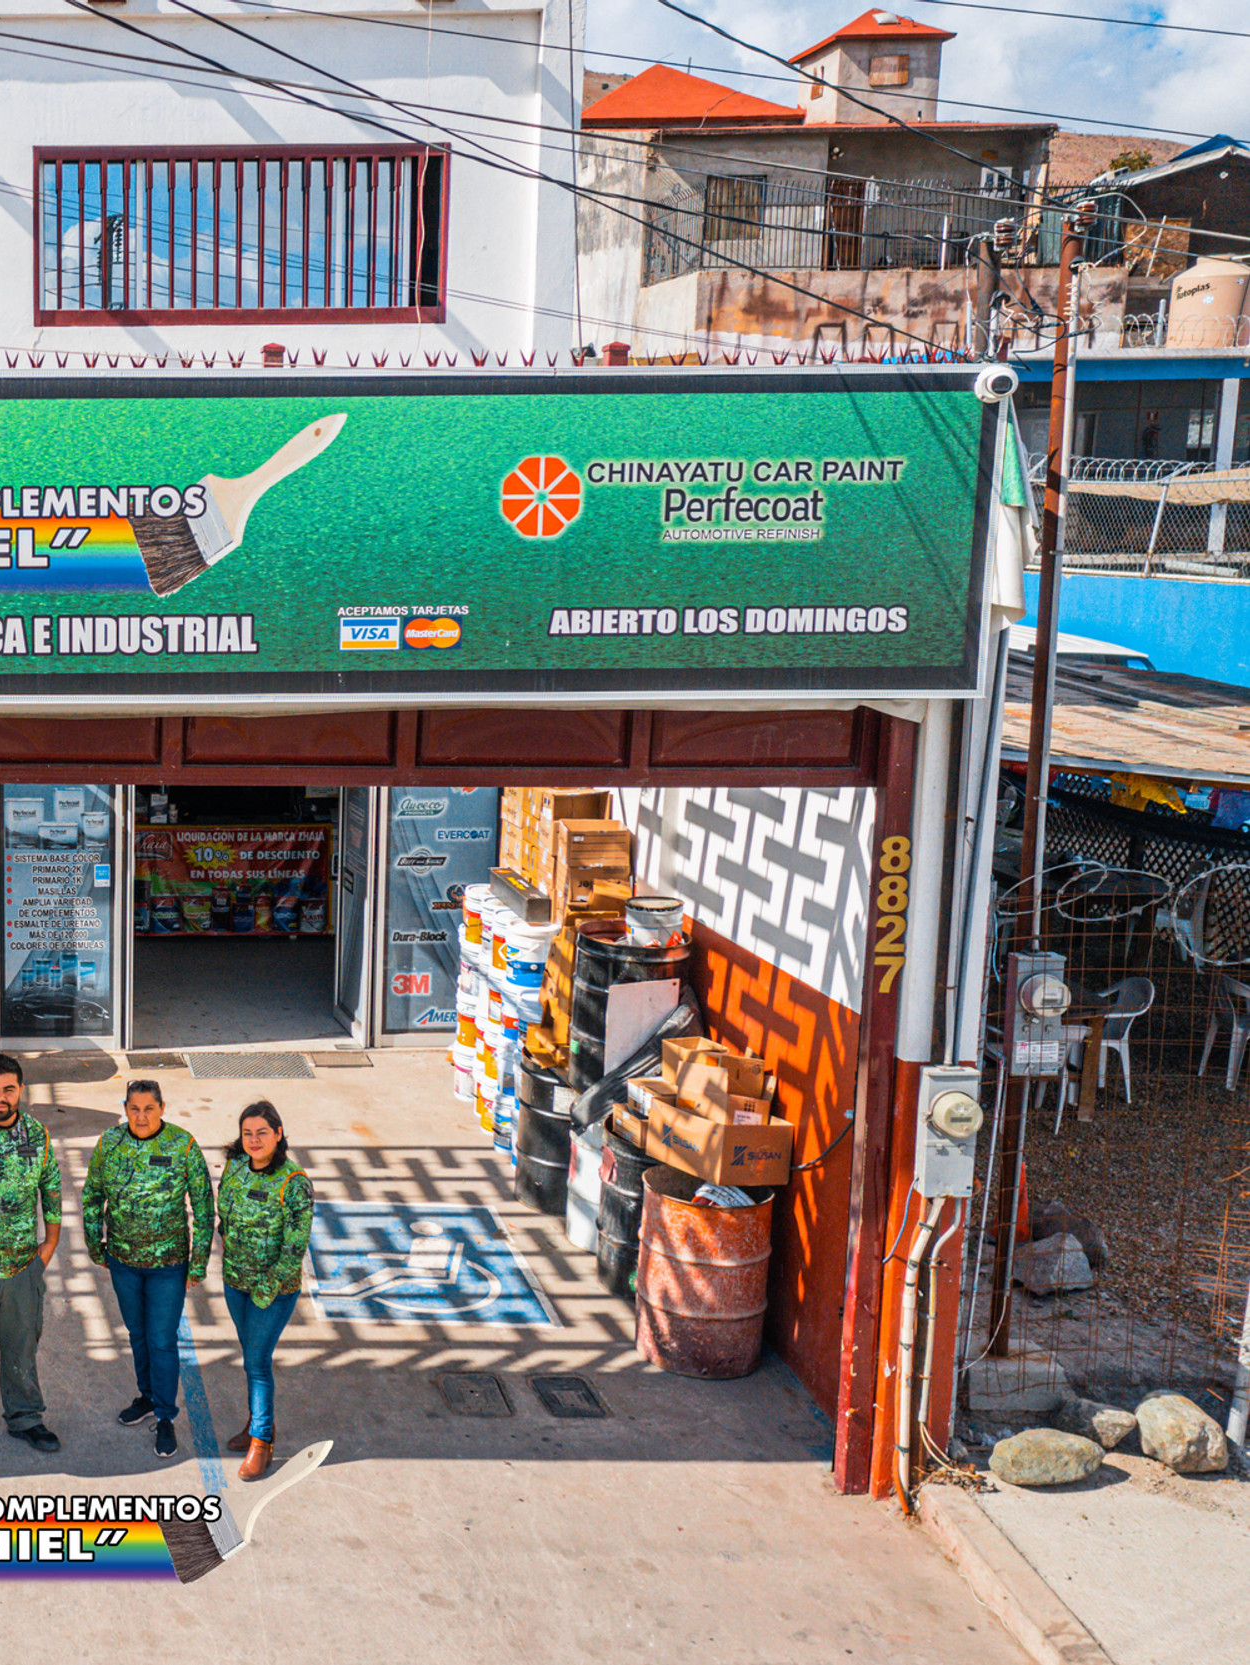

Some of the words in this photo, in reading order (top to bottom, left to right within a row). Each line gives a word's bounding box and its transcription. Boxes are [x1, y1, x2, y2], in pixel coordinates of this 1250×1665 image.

[587, 461, 744, 484] CHINAYATU
[753, 460, 816, 483] CAR
[823, 459, 904, 482] PAINT
[663, 486, 824, 523] Perfecoat
[662, 528, 753, 541] AUTOMOTIVE
[755, 527, 821, 540] REFINISH
[337, 606, 410, 616] ACEPTAMOS
[412, 605, 469, 615] TARJETAS
[548, 607, 678, 634] ABIERTO
[684, 606, 738, 633] LOS
[744, 606, 908, 633] DOMINGOS
[32, 616, 52, 655] E
[58, 616, 257, 654] INDUSTRIAL
[351, 628, 391, 641] VISA
[405, 627, 459, 641] MasterCard
[237, 832, 248, 842] DE
[251, 832, 262, 842] LA
[265, 832, 295, 842] MARCA
[437, 830, 490, 839] EVERCOAT
[14, 855, 48, 863] SISTEMA
[50, 855, 70, 863] BASE
[72, 854, 100, 863] COLOR
[240, 851, 254, 860] DE
[257, 851, 320, 860] DESCUENTO
[190, 870, 204, 878] EN
[208, 869, 243, 878] TODAS
[246, 869, 265, 878] SUS
[38, 887, 77, 895] MASILLAS
[23, 898, 51, 906] AMPLIA
[54, 898, 92, 906] VARIEDAD
[19, 909, 29, 917] DE
[31, 908, 96, 917] COMPLEMENTOS
[873, 836, 911, 994] 8827
[14, 920, 49, 928] ESMALTE
[51, 920, 62, 928] DE
[64, 919, 100, 928] URETANO
[393, 931, 447, 941] Dura-Block
[10, 942, 48, 950] COLORES
[50, 942, 60, 950] DE
[393, 974, 430, 995] 3M
